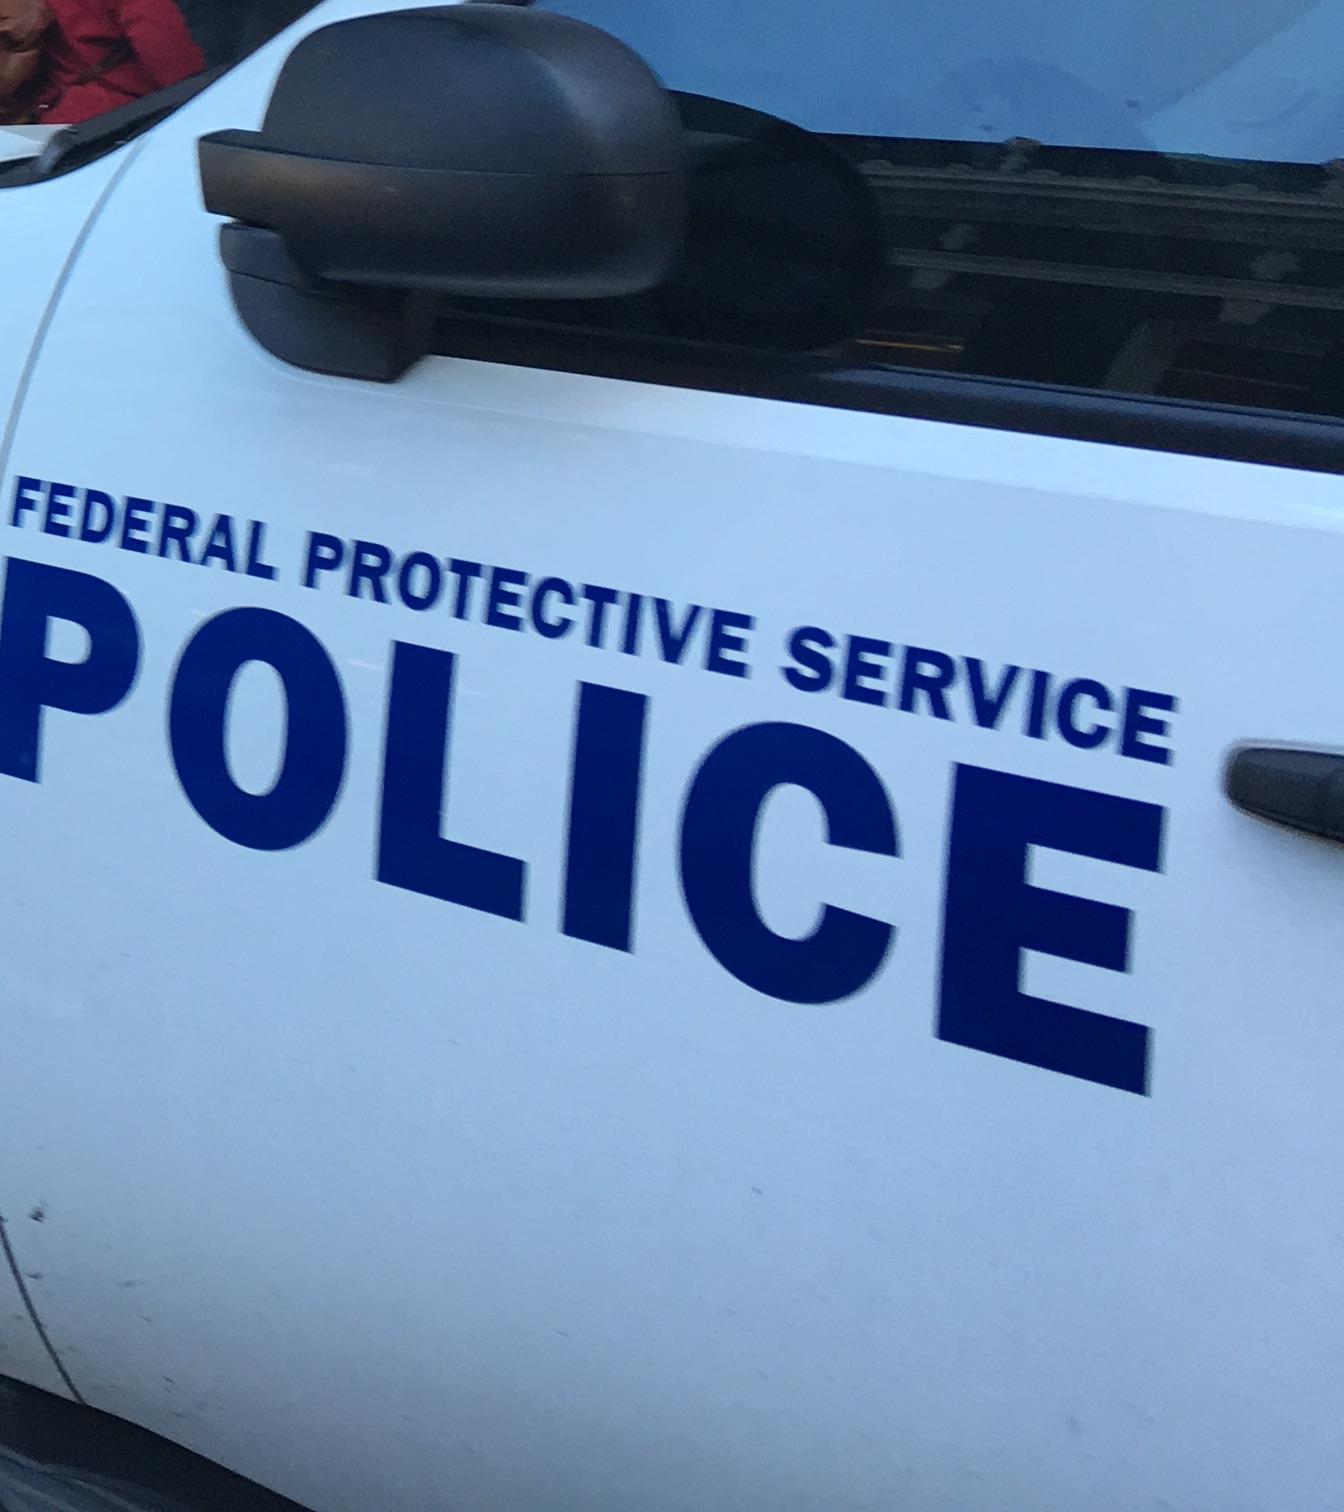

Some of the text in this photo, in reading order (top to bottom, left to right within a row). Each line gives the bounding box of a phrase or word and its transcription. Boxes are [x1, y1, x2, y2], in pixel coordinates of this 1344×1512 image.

[8, 475, 1179, 767] FEDERAL PROTECTIVE SERVICE
